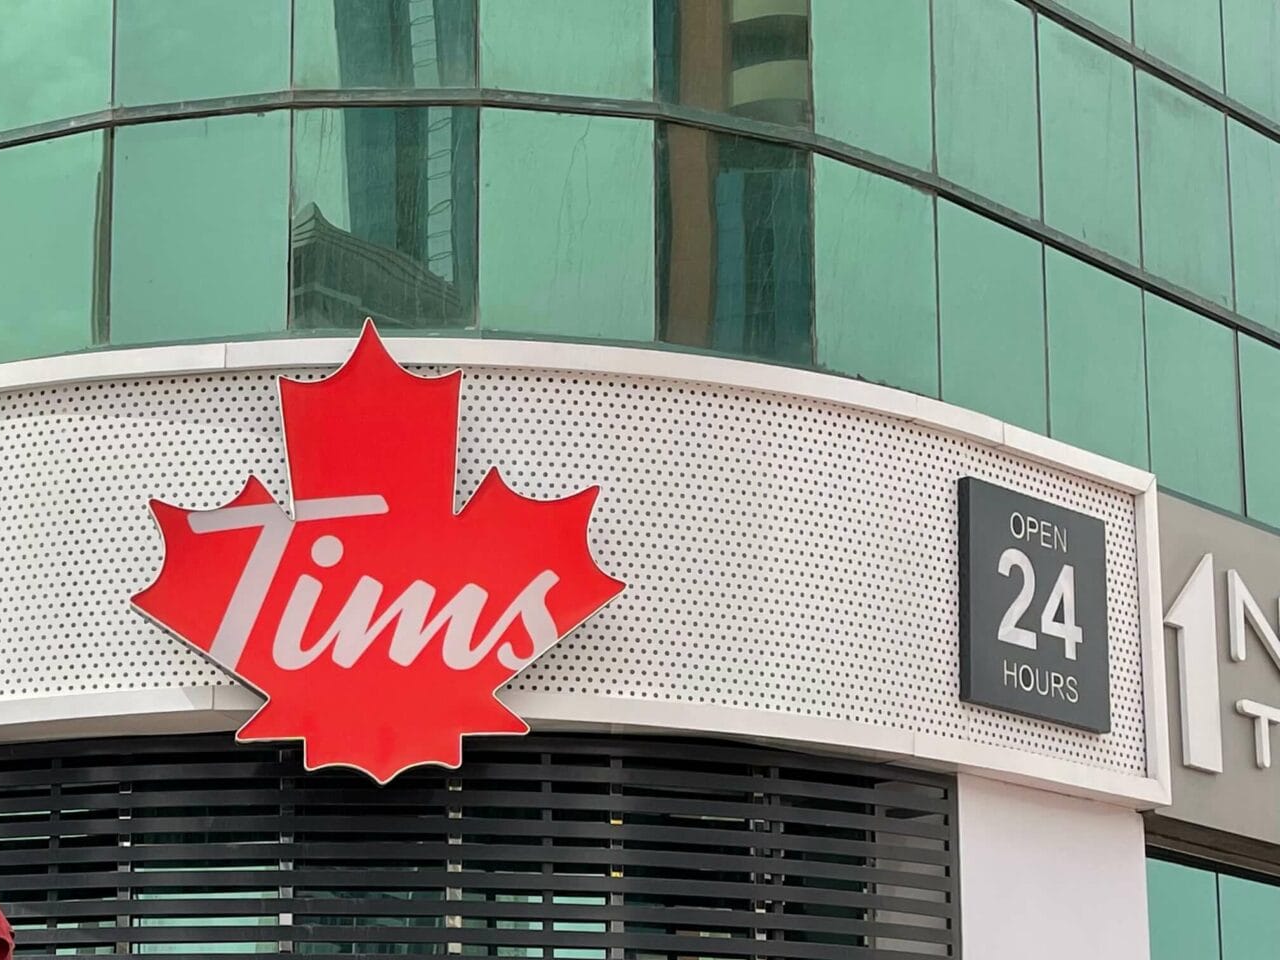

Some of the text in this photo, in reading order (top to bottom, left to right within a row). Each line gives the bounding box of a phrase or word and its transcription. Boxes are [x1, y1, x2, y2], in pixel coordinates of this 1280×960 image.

[1010, 512, 1067, 553] OPEN
[186, 494, 561, 672] Tims
[997, 548, 1083, 661] 24
[1003, 660, 1080, 703] HOURS
